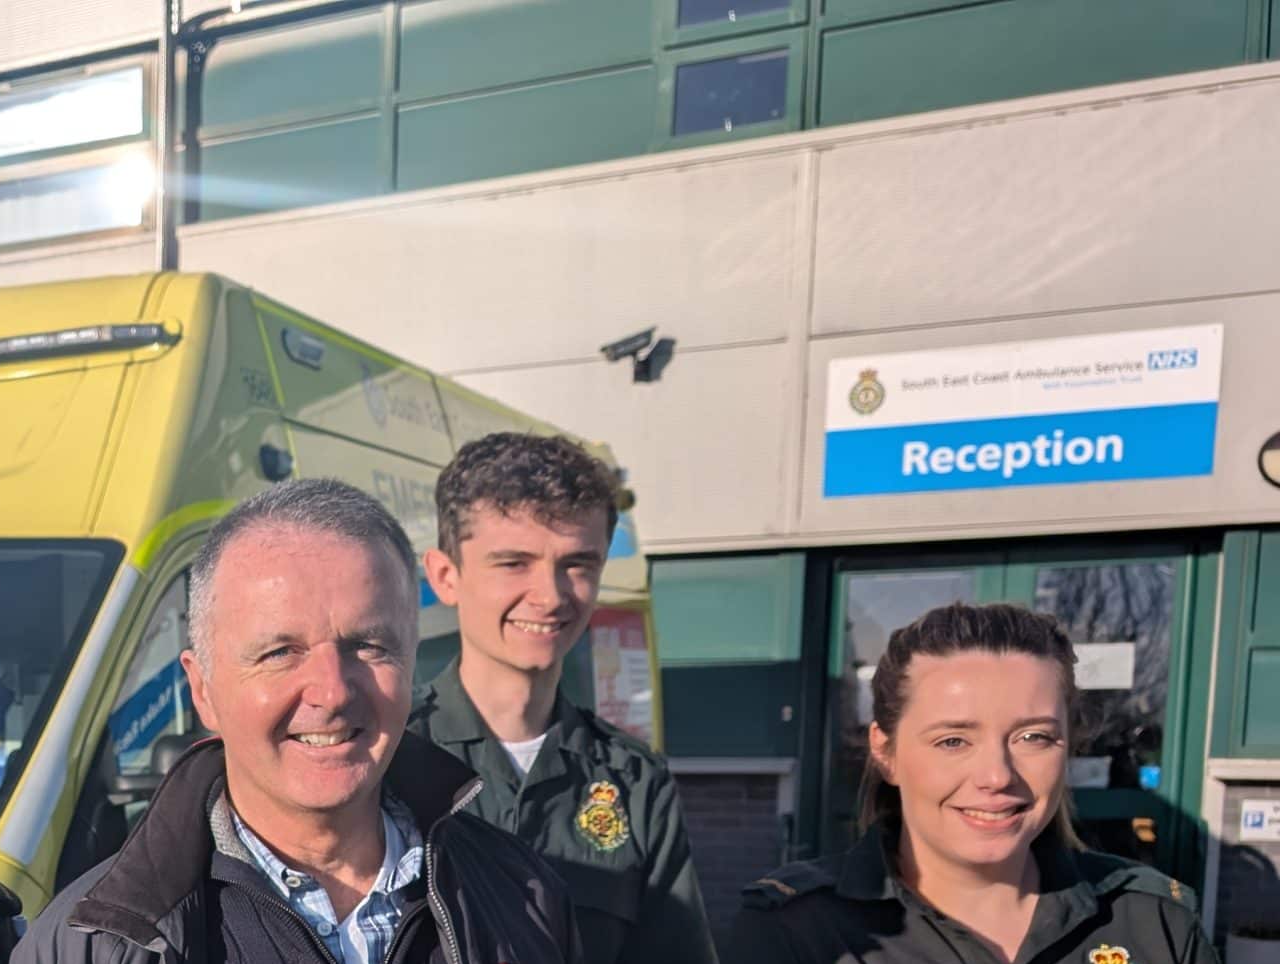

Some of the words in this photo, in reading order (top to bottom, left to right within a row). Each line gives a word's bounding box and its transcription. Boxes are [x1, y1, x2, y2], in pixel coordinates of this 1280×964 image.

[901, 376, 938, 391] South
[942, 374, 969, 387] East
[972, 371, 1009, 384] Coast
[1014, 363, 1091, 381] Ambulance
[1095, 359, 1143, 375] Service
[1150, 350, 1196, 370] NHS
[902, 430, 1123, 477] Reception
